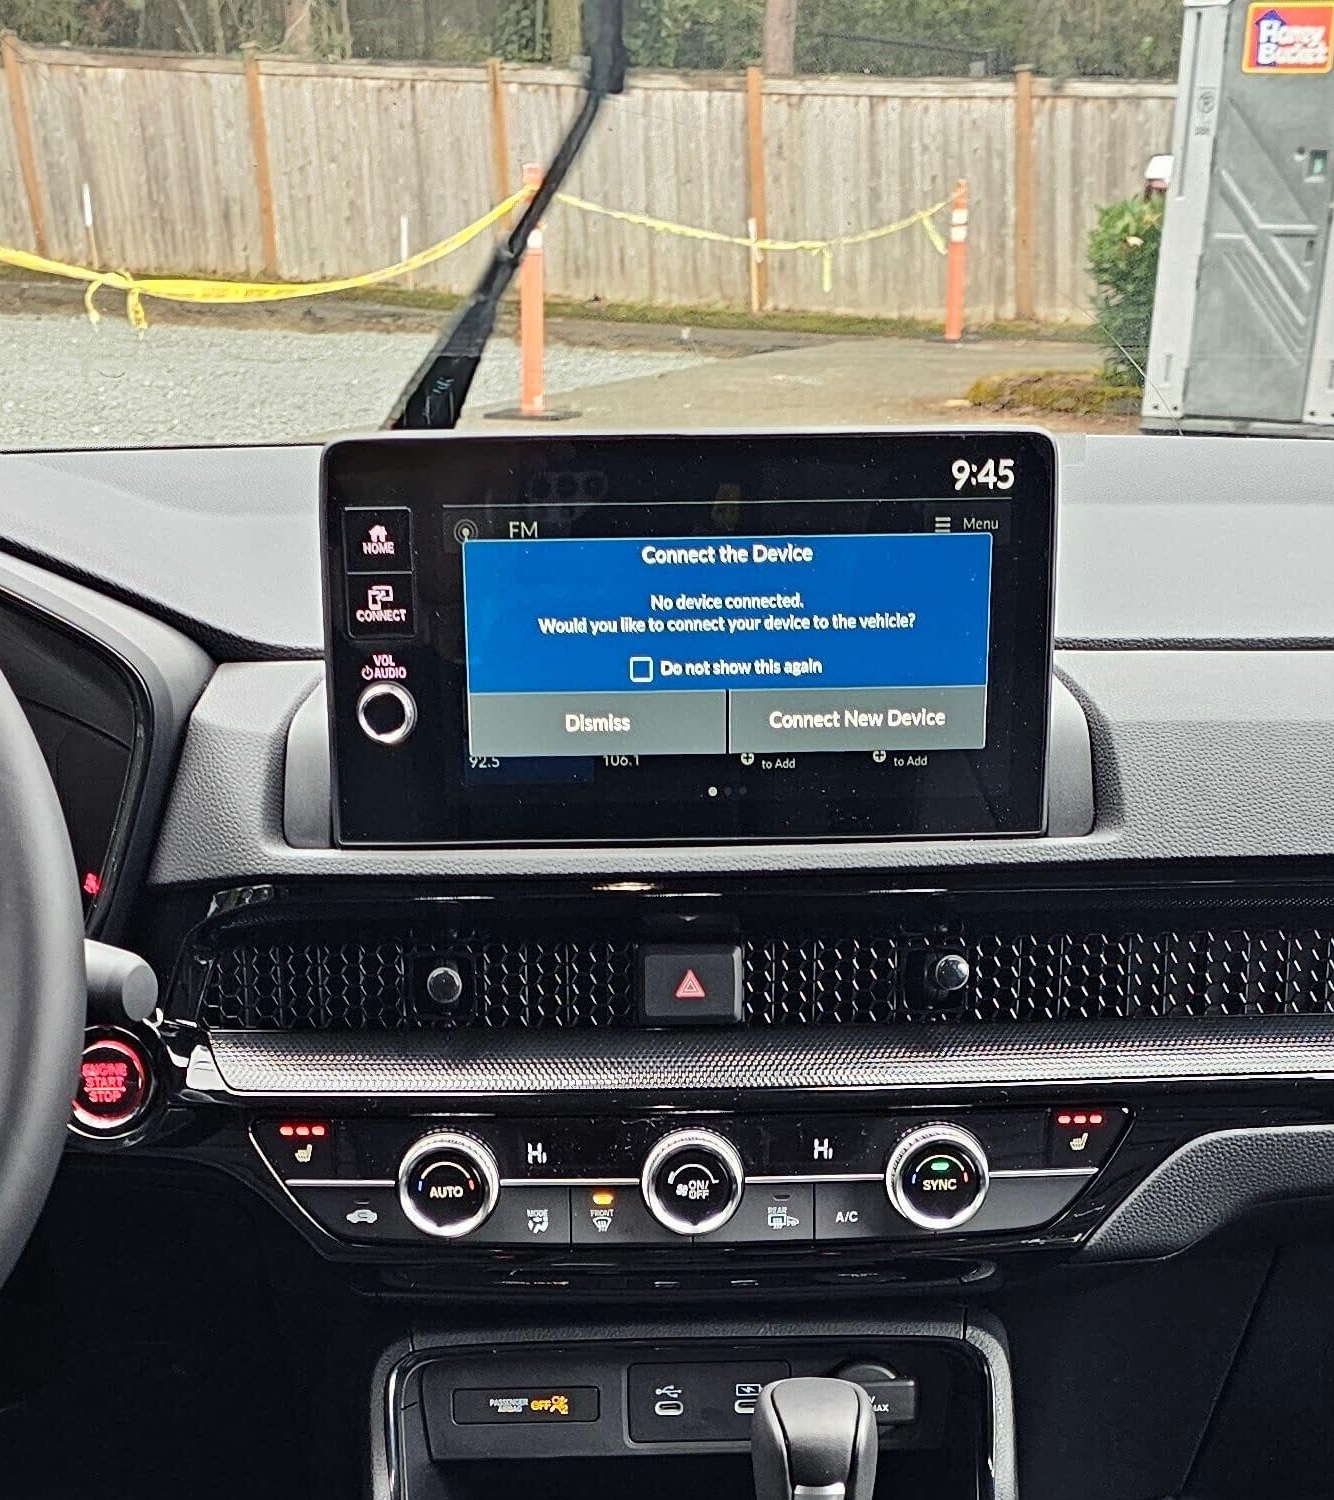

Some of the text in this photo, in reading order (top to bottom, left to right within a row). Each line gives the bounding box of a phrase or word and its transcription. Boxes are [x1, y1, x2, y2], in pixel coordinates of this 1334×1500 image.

[952, 458, 1015, 490] 9:45
[509, 521, 538, 539] FM
[963, 518, 999, 530] Menu
[363, 542, 395, 555] HOME
[641, 543, 814, 564] Connect the Device
[650, 592, 804, 611] No device connected.
[356, 609, 407, 622] CONNECT
[538, 612, 916, 635] Would you like to connect your device to the vehicle?
[373, 655, 395, 666] VOL
[660, 657, 822, 676] Do not show this again
[373, 667, 407, 679] AUDIO
[565, 713, 631, 733] Dismiss
[769, 708, 946, 729] Connect New Device
[468, 757, 500, 768] 92.5
[762, 758, 796, 769] to Add
[894, 756, 928, 767] to Add
[82, 1063, 127, 1078] ENGINE
[85, 1076, 126, 1087] START
[89, 1090, 122, 1102] STOP
[429, 1185, 464, 1198] AUTO
[922, 1178, 957, 1192] SYNC
[689, 1189, 709, 1199] OFF
[527, 1209, 548, 1217] MODE
[835, 1212, 858, 1223] A/C
[531, 1400, 551, 1410] OFF
